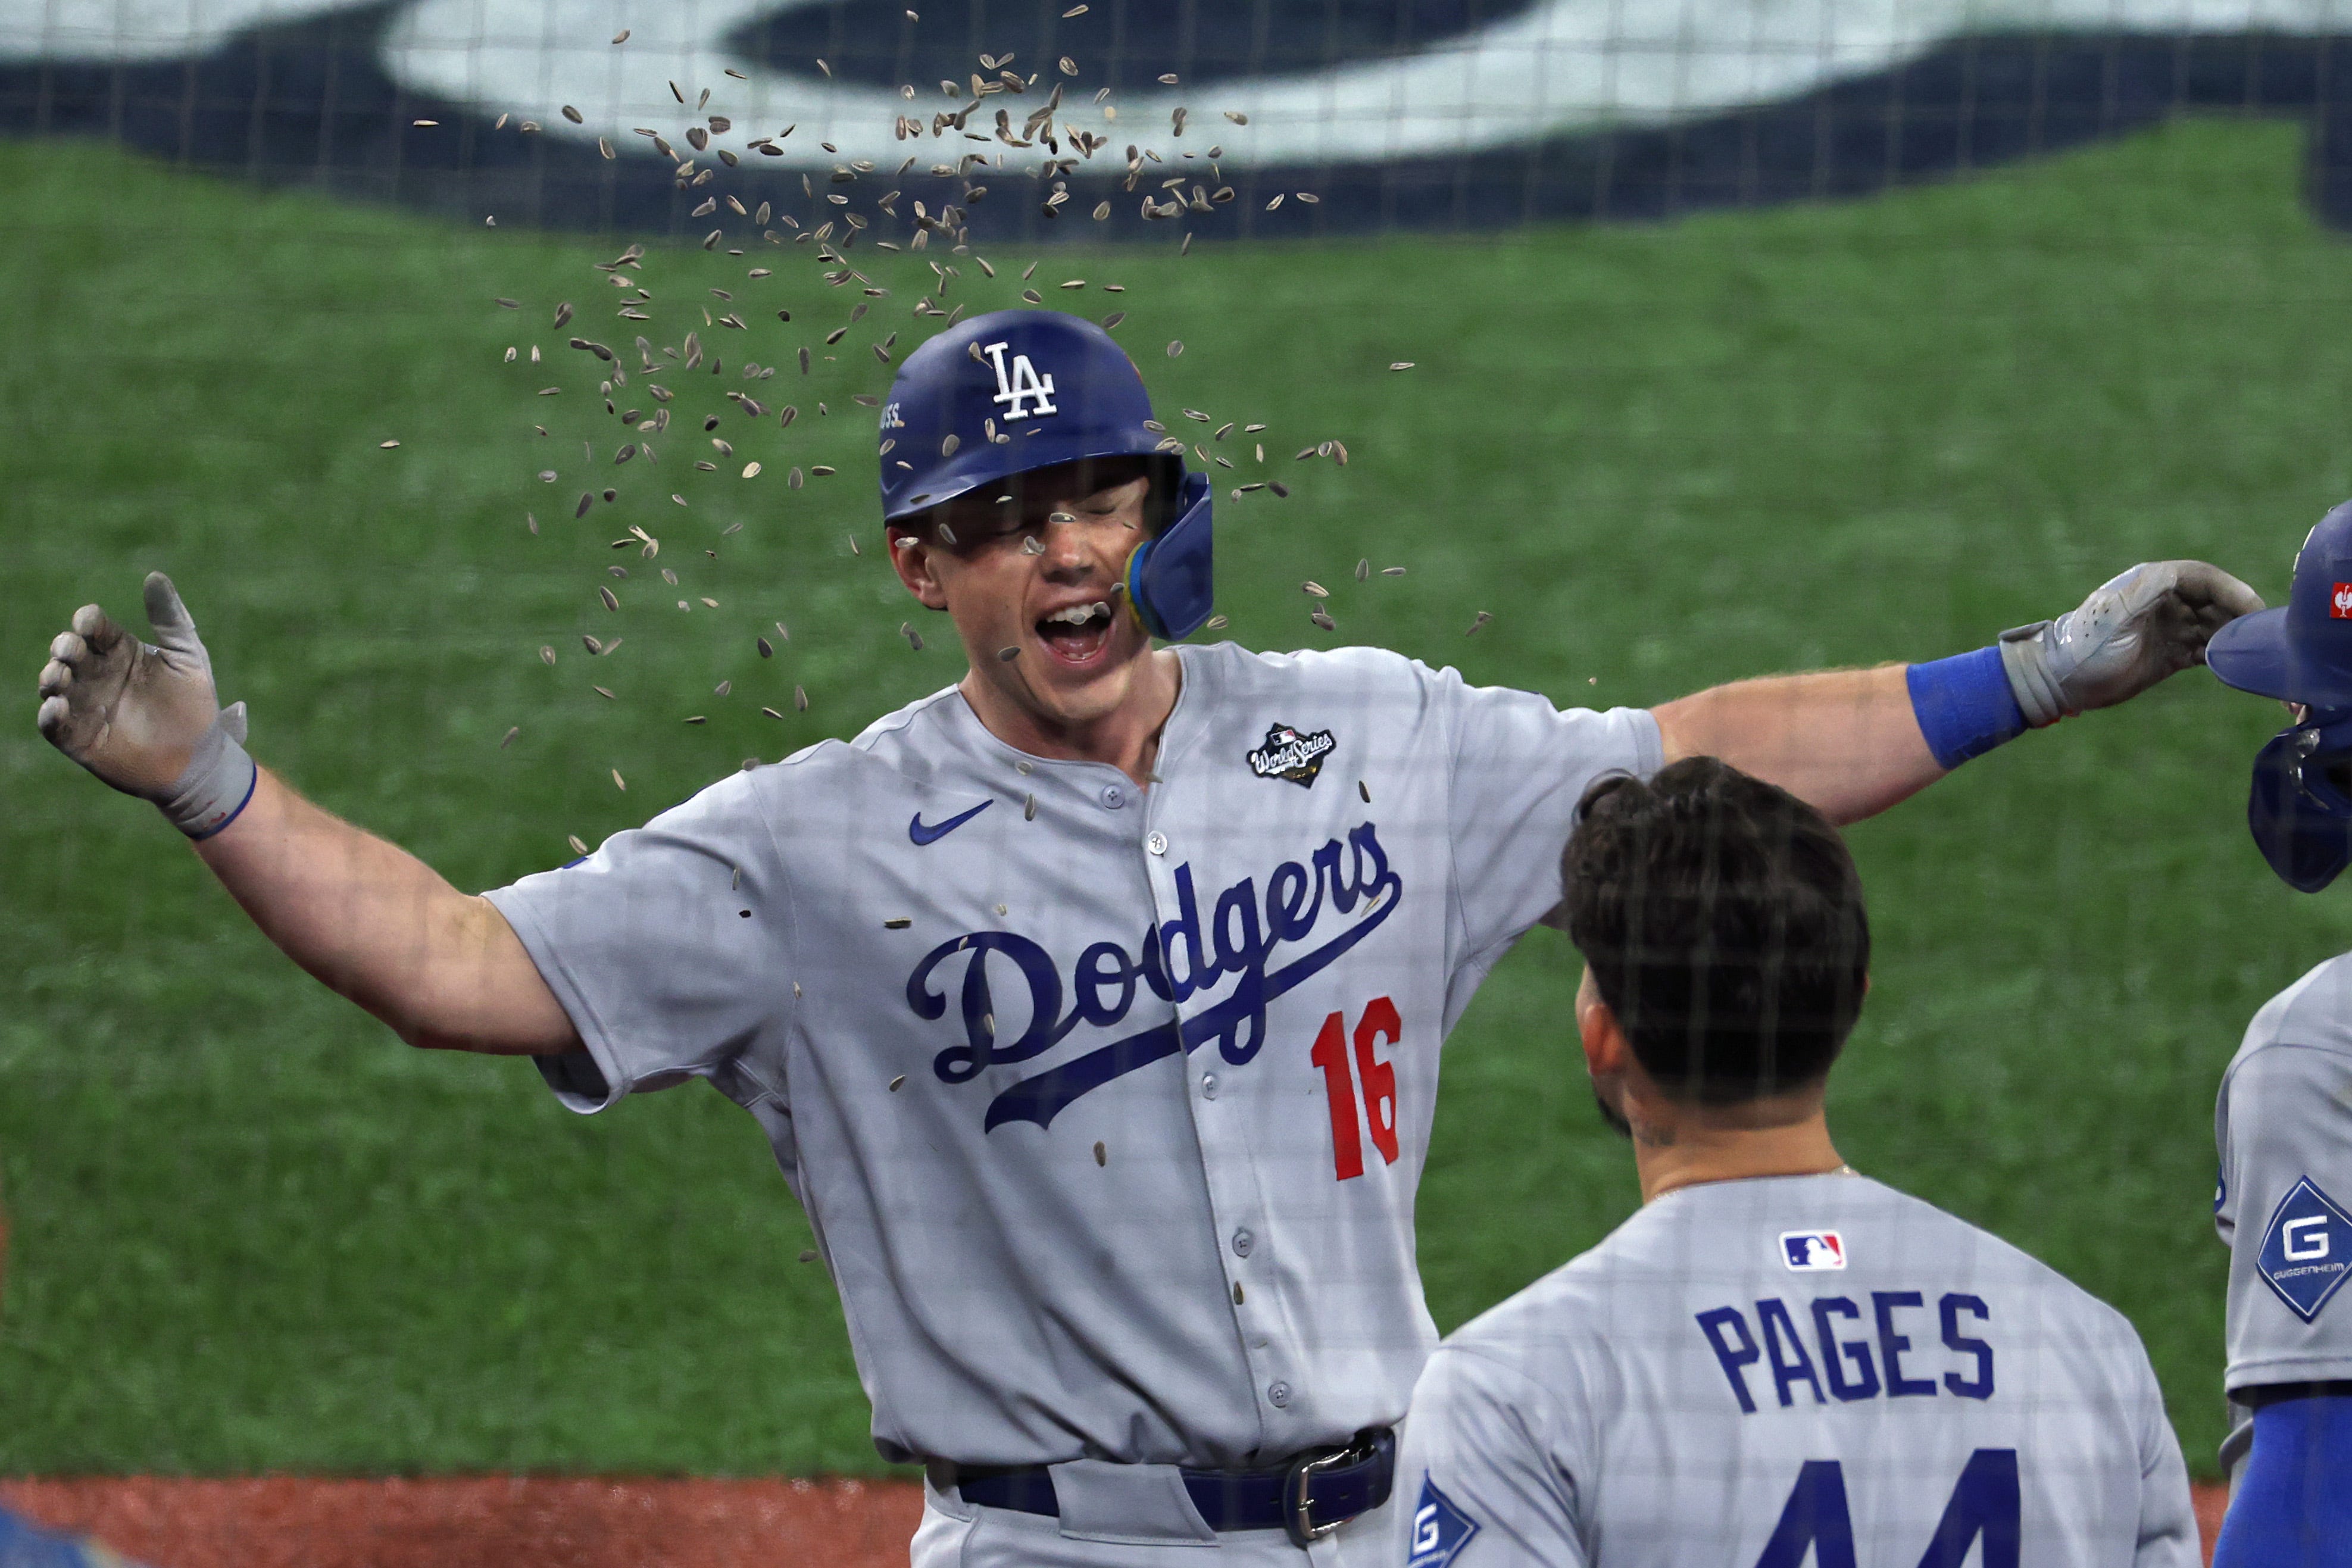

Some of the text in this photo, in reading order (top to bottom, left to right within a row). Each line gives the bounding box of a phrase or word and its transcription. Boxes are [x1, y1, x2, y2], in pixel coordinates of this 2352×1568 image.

[984, 341, 1057, 421] LA
[1251, 733, 1333, 774] World Series
[907, 821, 1402, 1085] Dodgers
[1311, 996, 1401, 1181] 16
[2273, 1263, 2344, 1280] GUGGENHEIM
[2282, 1215, 2329, 1262] G
[1694, 1291, 1995, 1415] PAGES
[1413, 1503, 1439, 1556] G
